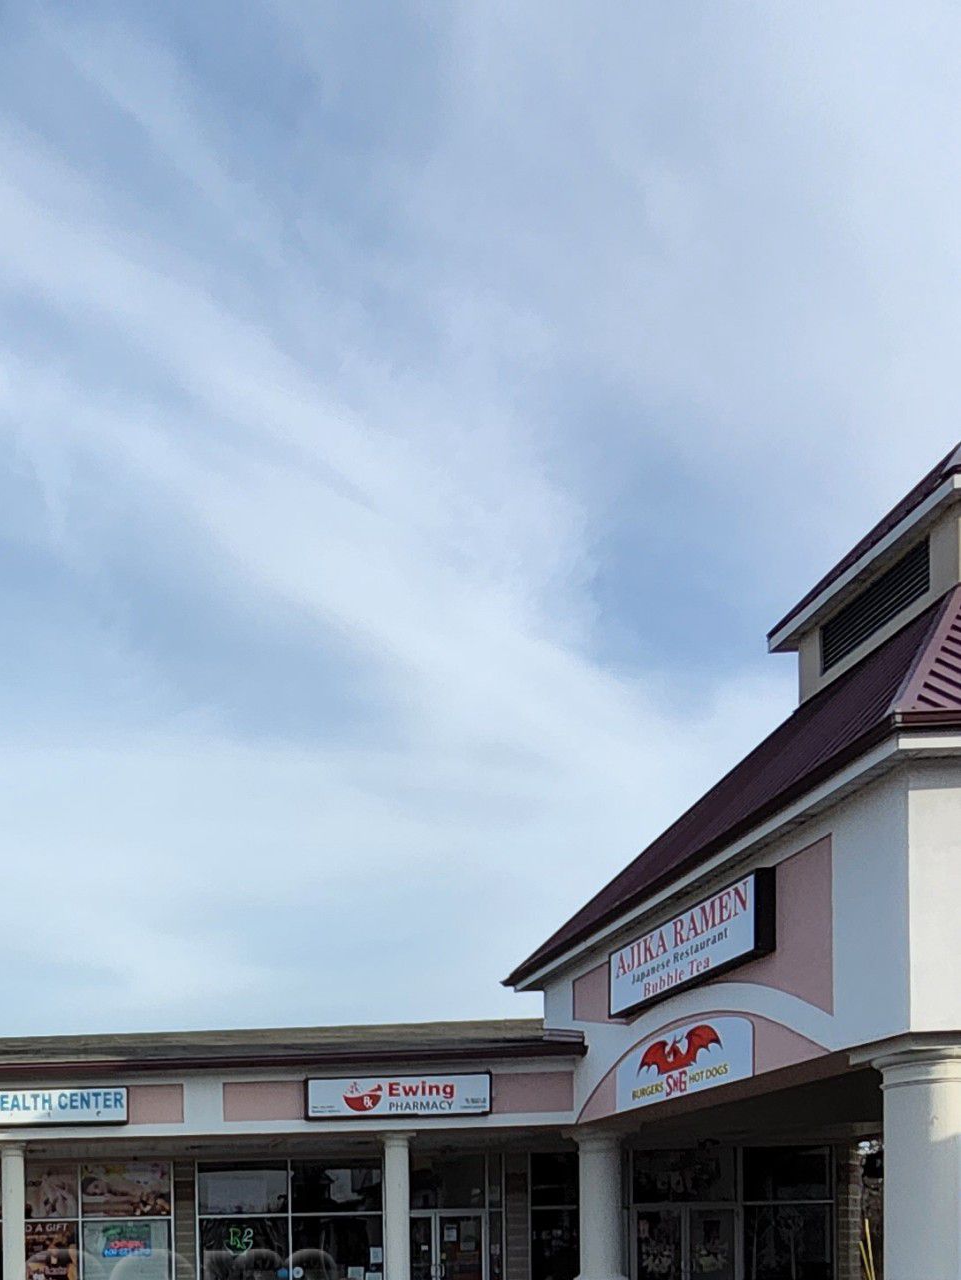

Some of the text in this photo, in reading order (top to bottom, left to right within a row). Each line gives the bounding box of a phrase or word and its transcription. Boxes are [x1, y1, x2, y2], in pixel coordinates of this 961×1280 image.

[615, 880, 750, 980] AJIKA RAMEN
[631, 927, 729, 985] Japanese Restaurant
[642, 956, 711, 998] Bubble Tea
[388, 1081, 455, 1099] Ewing
[631, 1081, 665, 1101] BURGERS
[688, 1071, 705, 1085] HOT
[705, 1063, 729, 1080] DOGS
[57, 1091, 125, 1110] CENTER
[389, 1099, 455, 1112] PHARMACY
[45, 1222, 68, 1232] GIFT
